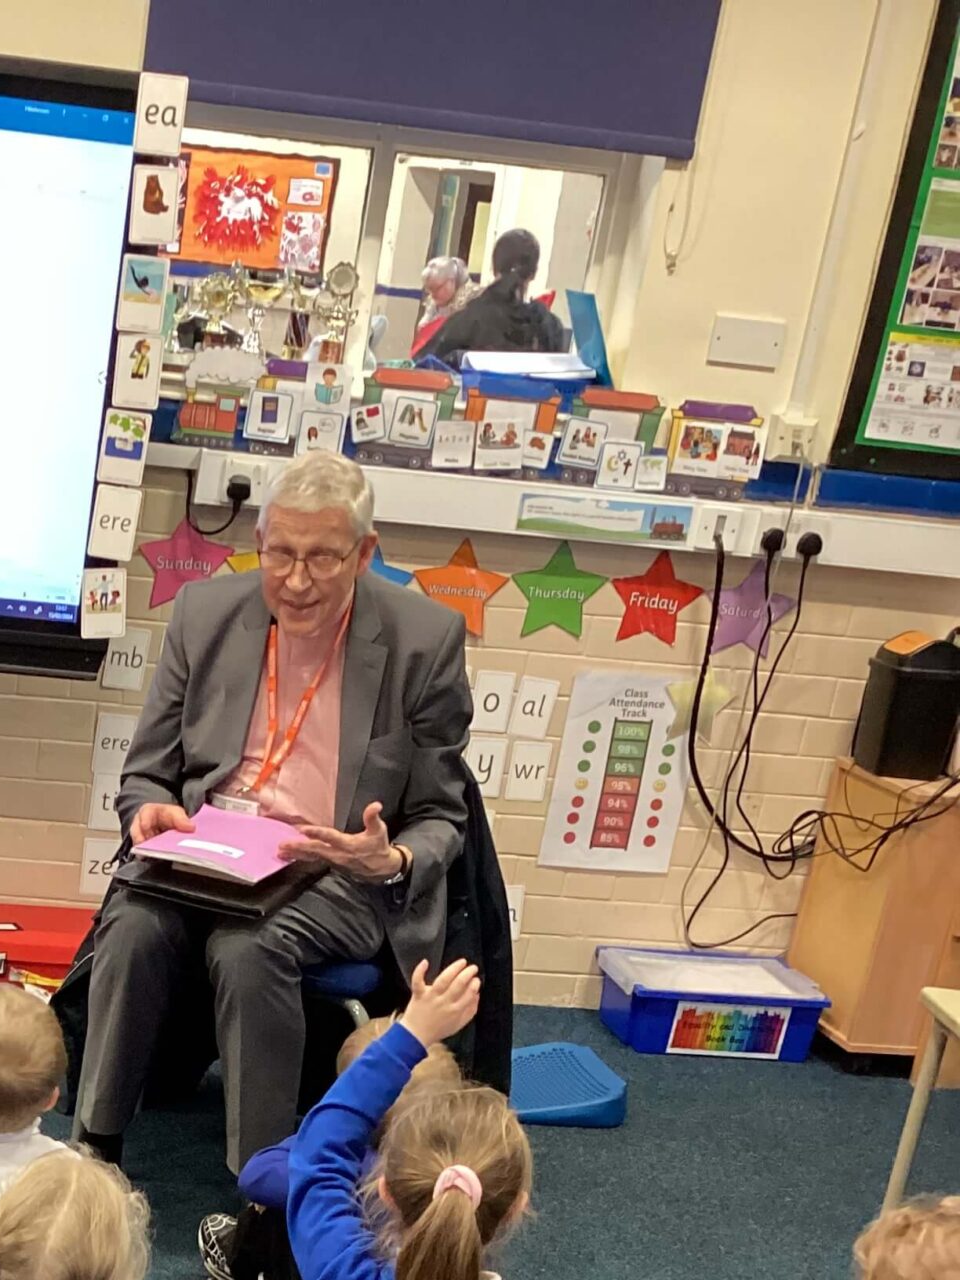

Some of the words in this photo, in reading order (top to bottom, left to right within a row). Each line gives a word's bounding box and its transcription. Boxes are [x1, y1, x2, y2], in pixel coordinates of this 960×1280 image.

[145, 104, 178, 127] ea
[99, 514, 131, 532] ere
[156, 556, 212, 576] Sunday
[428, 584, 488, 600] Wednesday
[528, 586, 585, 602] Thursday
[629, 591, 678, 614] Friday
[110, 648, 143, 669] mb
[624, 688, 648, 698] Class
[483, 692, 500, 712] o
[522, 694, 546, 718] al
[608, 698, 666, 710] Attendance
[622, 709, 648, 718] Track
[618, 726, 644, 737] 100%
[101, 736, 130, 751] ere
[618, 745, 639, 756] 98%
[478, 754, 494, 784] y
[514, 764, 545, 780] wr
[614, 763, 635, 774] 96%
[611, 781, 632, 792] 95%
[608, 798, 628, 808] 94%
[604, 816, 624, 827] 90%
[600, 833, 620, 844] 85%
